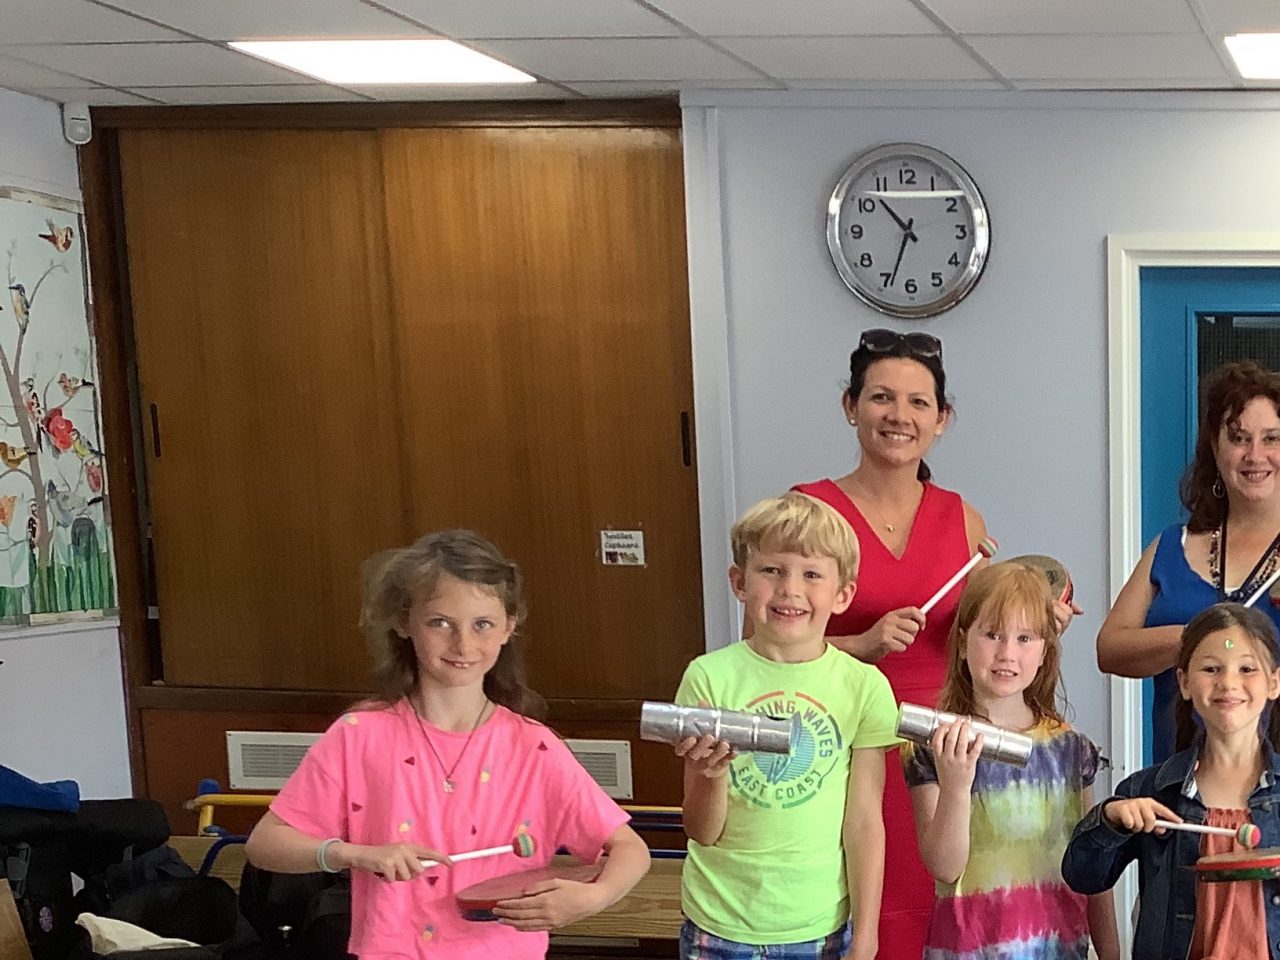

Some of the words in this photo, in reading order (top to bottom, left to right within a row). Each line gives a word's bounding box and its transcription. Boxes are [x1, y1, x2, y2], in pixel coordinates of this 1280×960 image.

[876, 176, 888, 192] 11
[899, 168, 917, 185] 12
[858, 198, 876, 213] 10
[944, 197, 958, 213] 2
[850, 224, 864, 239] 9
[954, 224, 967, 240] 3
[860, 252, 873, 268] 8
[947, 251, 960, 267] 4
[879, 272, 892, 288] 7
[904, 278, 918, 294] 6
[931, 272, 943, 287] 5
[803, 706, 833, 758] WAVES
[738, 766, 768, 797] EAST
[775, 768, 821, 800] COAST
